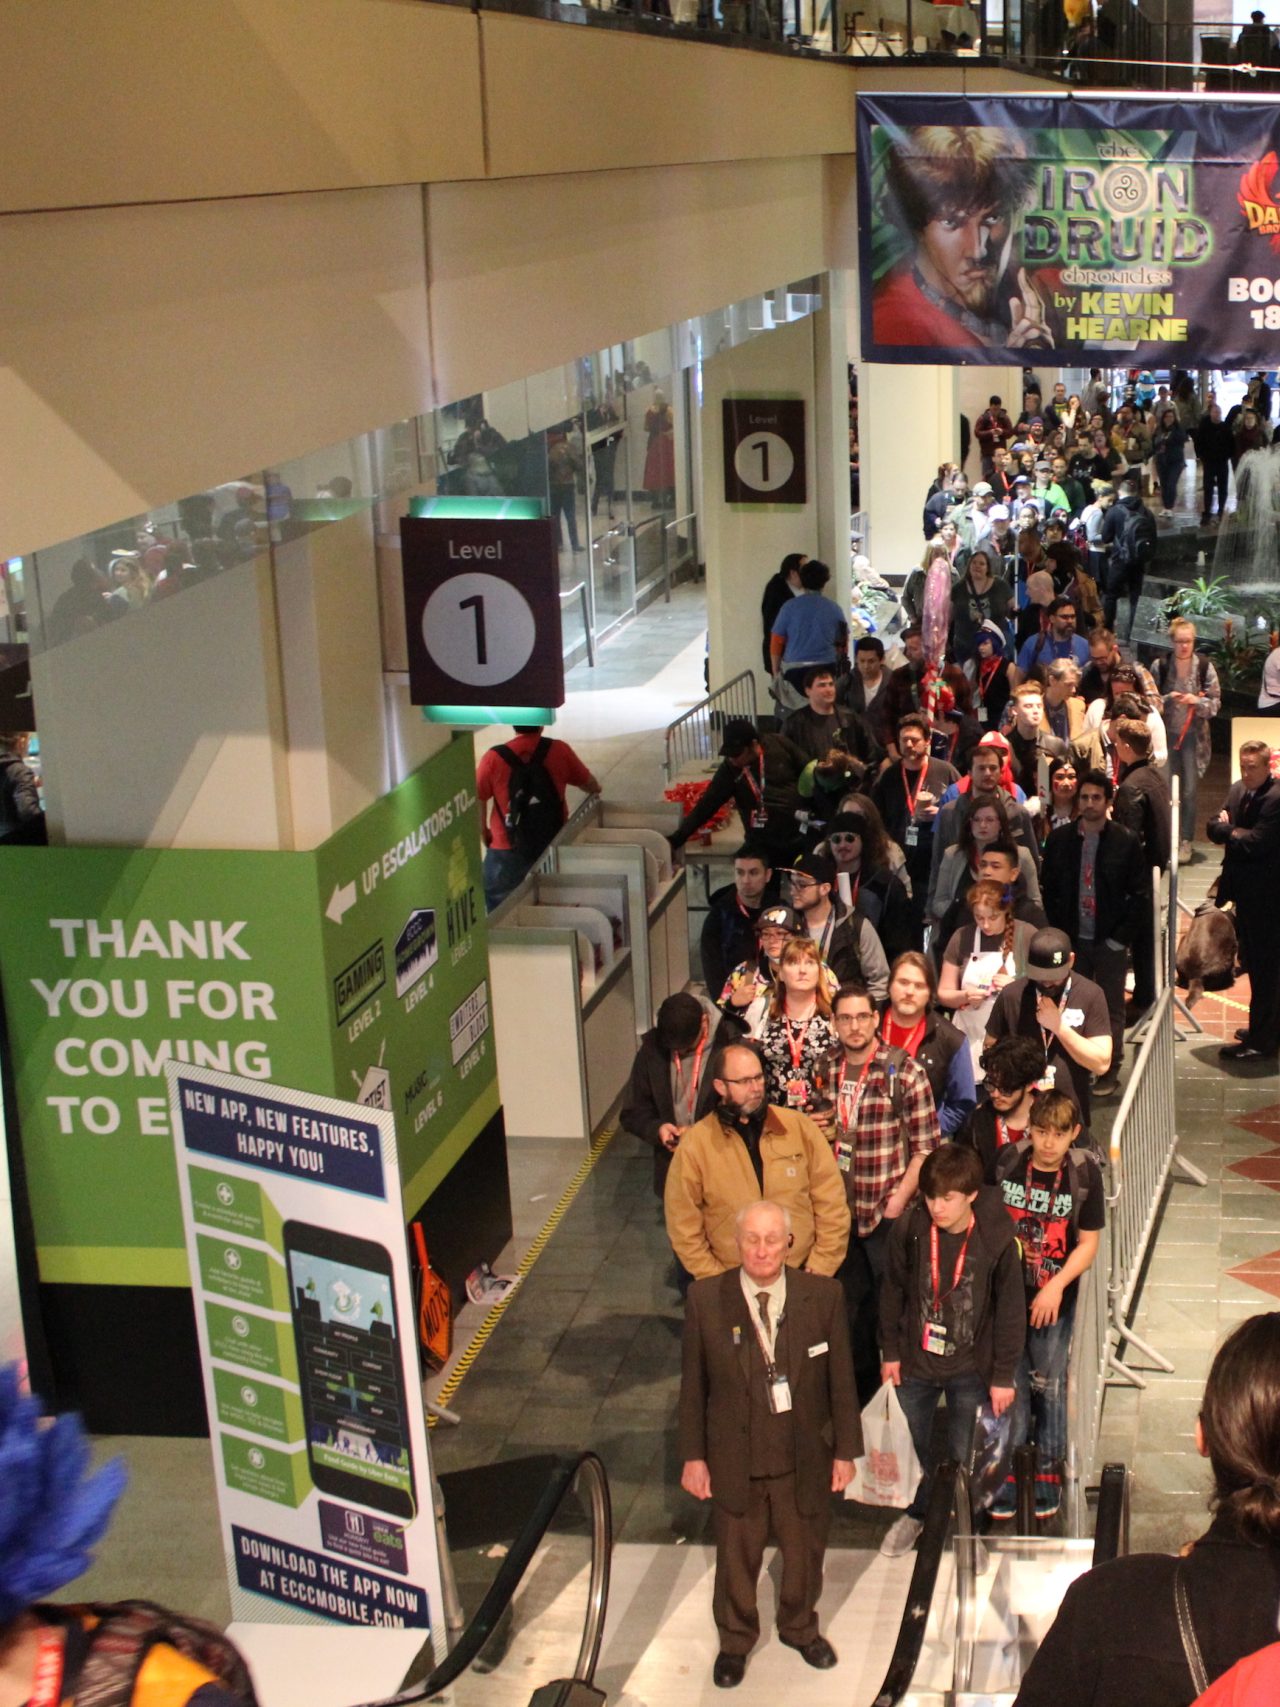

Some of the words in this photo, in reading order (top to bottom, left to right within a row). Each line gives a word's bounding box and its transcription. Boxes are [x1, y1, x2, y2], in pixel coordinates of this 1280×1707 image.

[1042, 164, 1189, 216] IRON
[1023, 215, 1211, 262] DRUID
[1054, 293, 1076, 314] by
[1081, 292, 1174, 316] KEVIN
[1066, 318, 1188, 342] HEARNE
[749, 415, 778, 425] Level
[751, 441, 769, 482] 1
[449, 540, 503, 560] Level
[459, 595, 488, 665] 1
[362, 861, 380, 896] UP
[382, 802, 453, 880] ESCALATORS
[447, 886, 477, 949] HIVE
[50, 918, 252, 961] THANK
[30, 978, 149, 1019] YOU
[167, 980, 277, 1021] FOR
[338, 950, 383, 1007] GAMING
[405, 980, 427, 1014] LEVEL
[348, 1008, 374, 1044] LEVEL
[375, 1000, 382, 1018] 2
[55, 1038, 271, 1080] COMING
[47, 1096, 120, 1135] TO
[138, 1098, 169, 1136] E
[185, 1089, 215, 1115] NEW
[221, 1098, 252, 1126] APP,
[256, 1107, 287, 1133] NEW
[292, 1115, 374, 1157] FEATURES,
[414, 1097, 437, 1134] LEVEL
[237, 1133, 284, 1163] HAPPY
[289, 1146, 324, 1174] YOU!
[373, 1530, 403, 1550] eats
[240, 1536, 317, 1578] DOWNLOAD
[321, 1563, 349, 1590] THE
[354, 1575, 381, 1599] APP
[386, 1585, 418, 1613] NOW
[260, 1569, 276, 1591] AT
[281, 1577, 405, 1629] ECCCMOBILE.COM
